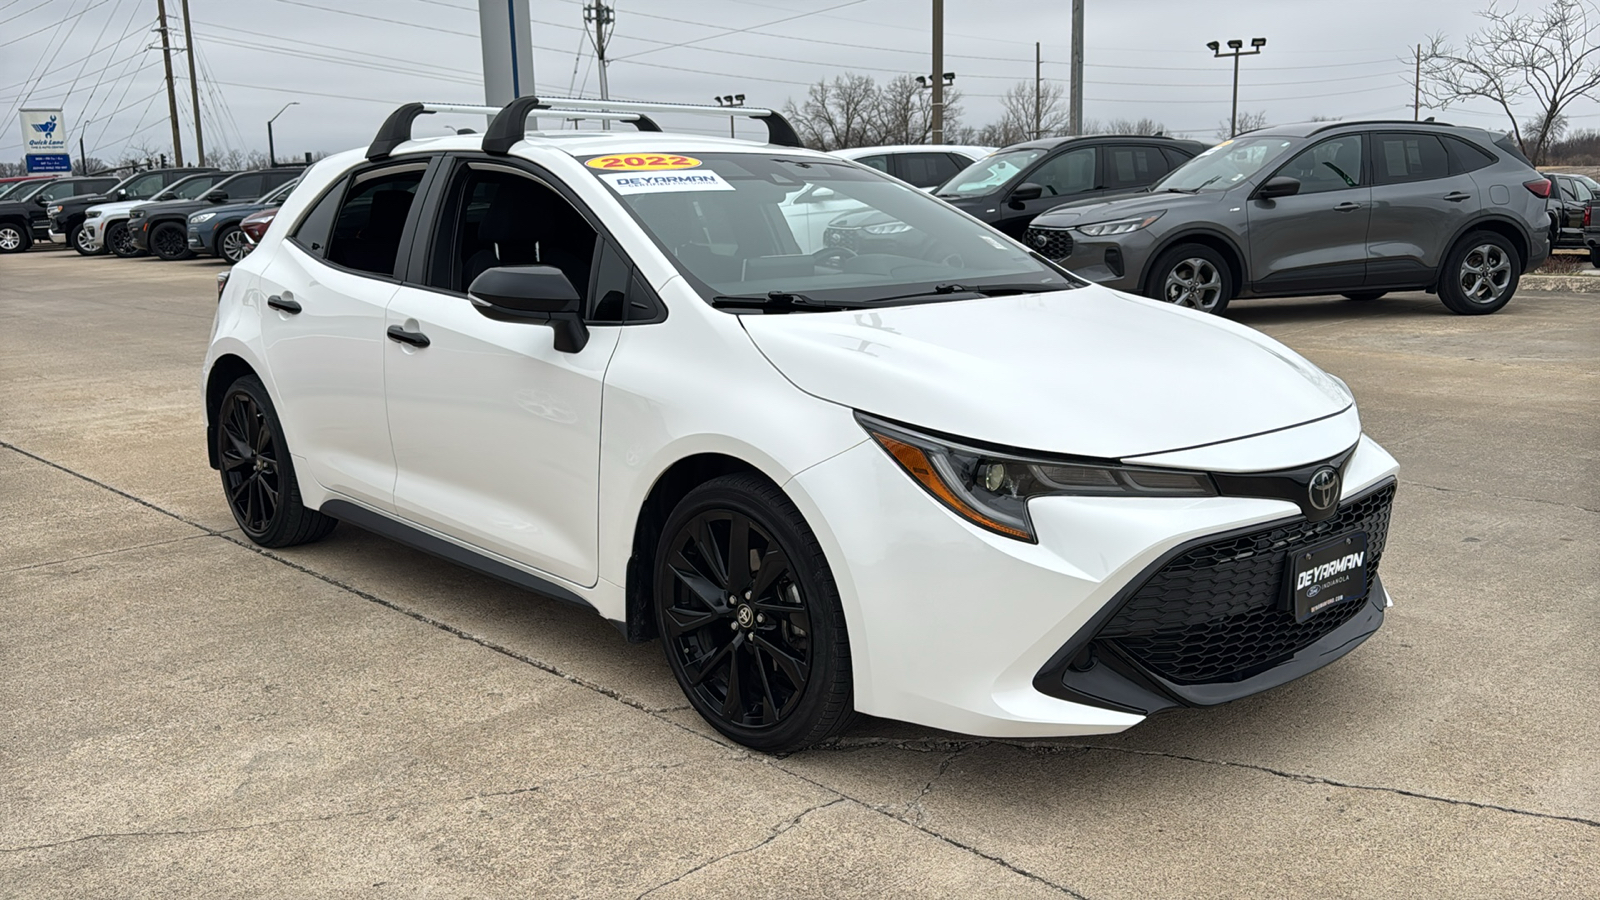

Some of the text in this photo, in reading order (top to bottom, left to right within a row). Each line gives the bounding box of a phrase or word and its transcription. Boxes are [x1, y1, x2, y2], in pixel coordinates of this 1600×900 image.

[601, 156, 692, 168] 2022
[616, 176, 716, 186] DEYARMAN
[1297, 551, 1364, 591] DEYARMAN
[1321, 575, 1350, 590] INDIANOLA
